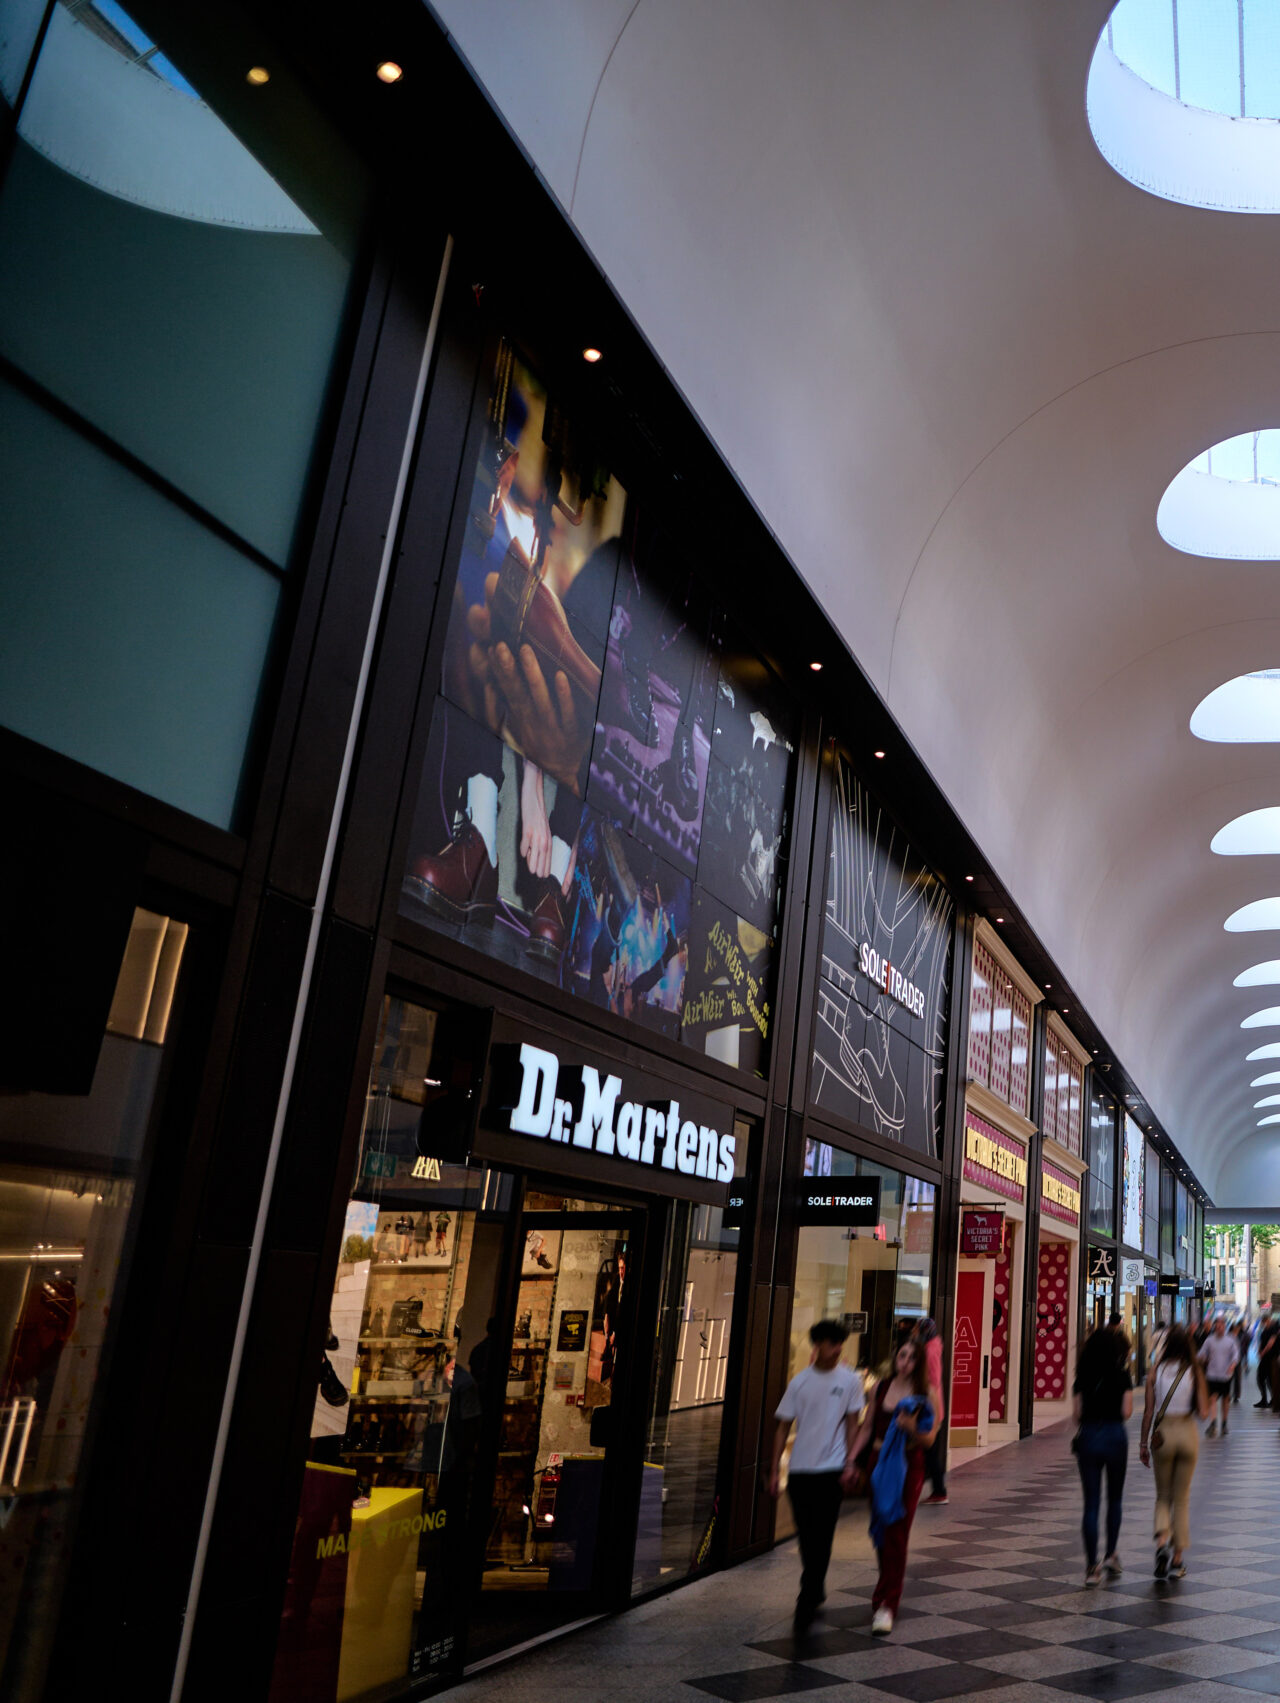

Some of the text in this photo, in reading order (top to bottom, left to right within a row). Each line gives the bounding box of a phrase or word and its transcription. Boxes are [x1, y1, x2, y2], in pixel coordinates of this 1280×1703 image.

[834, 1196, 873, 1206] TRADER
[966, 1227, 999, 1235] VICTORIA'S
[970, 1235, 992, 1243] SECRET
[974, 1242, 988, 1251] PINK
